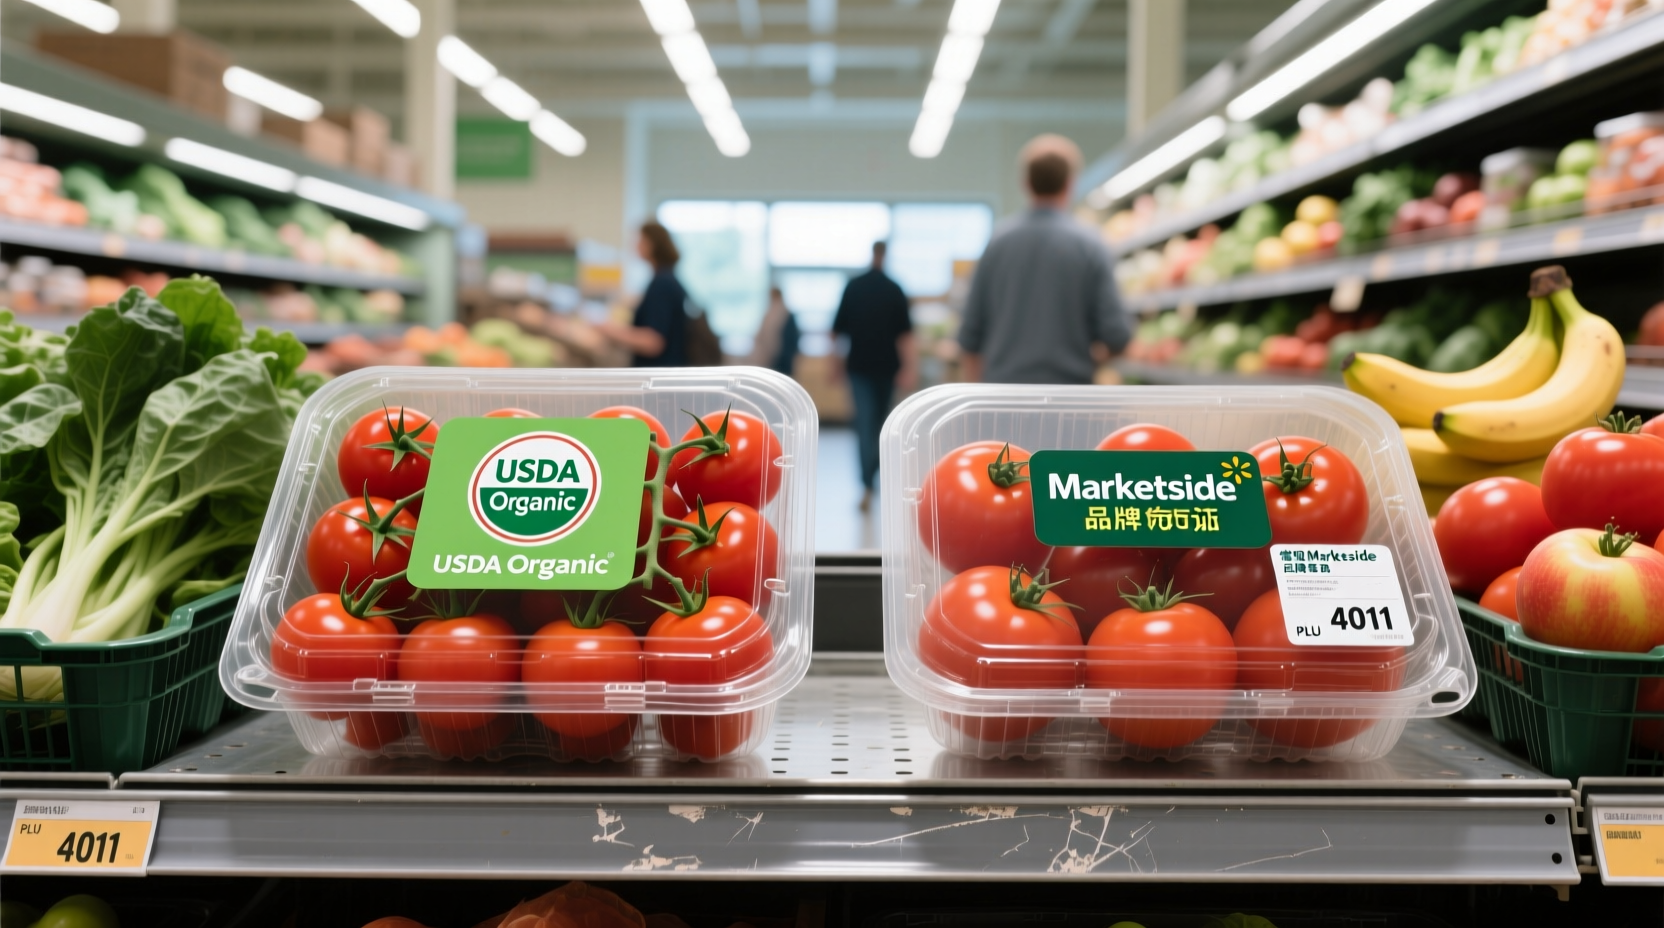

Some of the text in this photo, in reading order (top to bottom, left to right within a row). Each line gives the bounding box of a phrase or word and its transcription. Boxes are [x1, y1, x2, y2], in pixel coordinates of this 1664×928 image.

[495, 458, 580, 483] USDA
[1048, 472, 1237, 502] Marketside
[489, 490, 576, 517] Organic
[433, 554, 502, 574] USDA
[1296, 606, 1393, 637] PLU 4011
[20, 823, 42, 834] PLU
[56, 831, 121, 864] 4011
